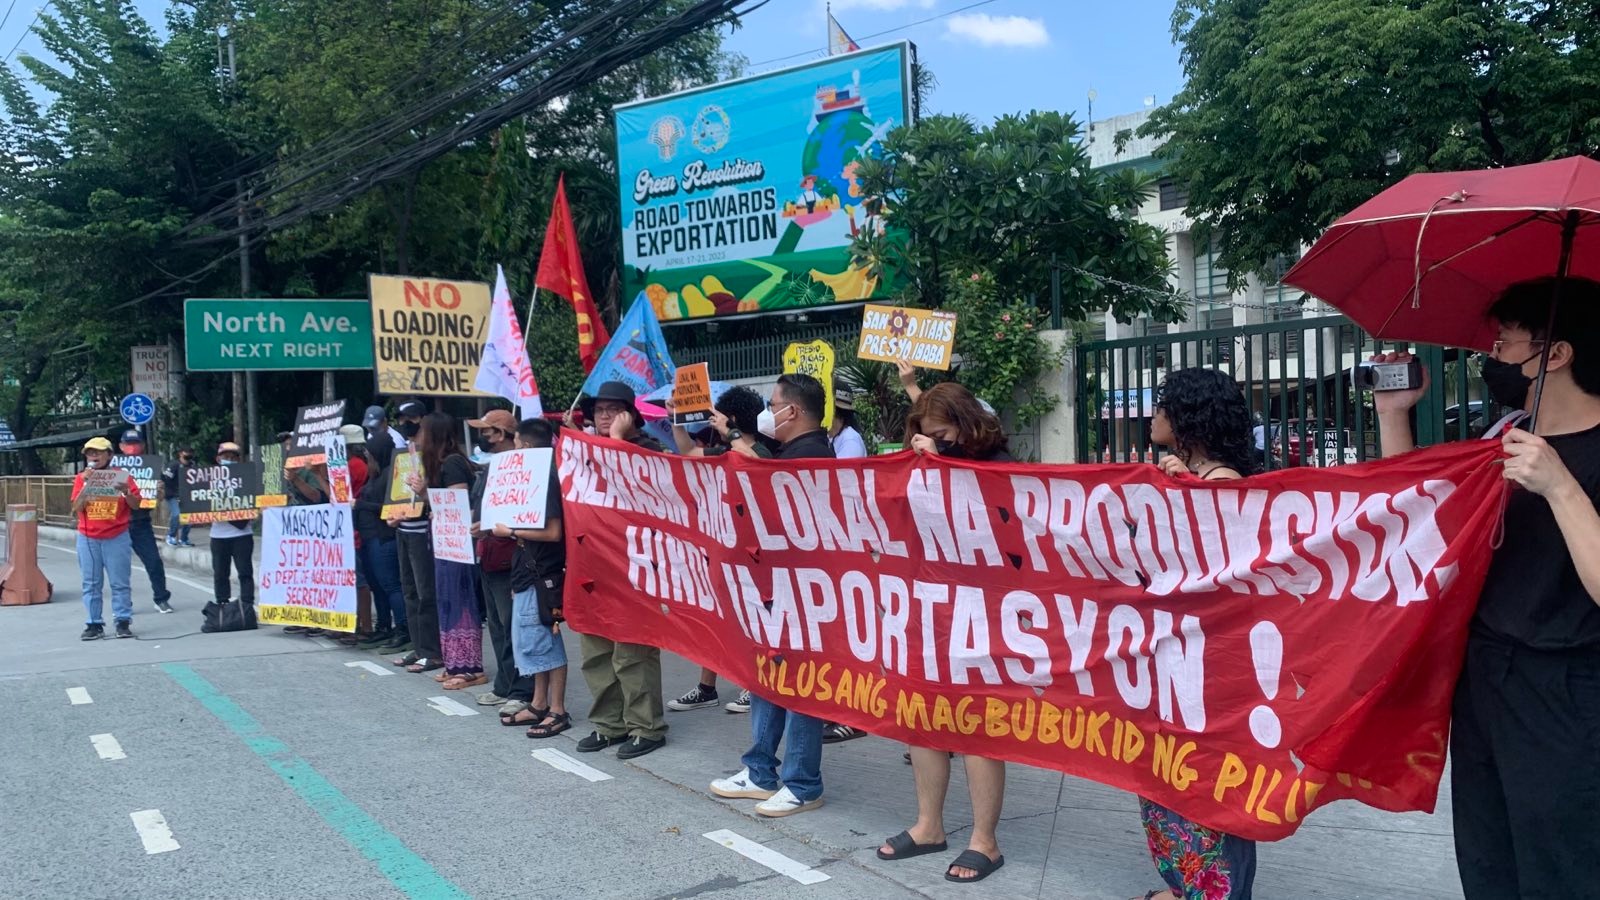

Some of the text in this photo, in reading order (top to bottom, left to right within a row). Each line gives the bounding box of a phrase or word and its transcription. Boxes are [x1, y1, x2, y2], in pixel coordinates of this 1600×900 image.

[633, 158, 764, 202] Green Revolution
[634, 187, 776, 230] ROAD TOWARDS
[636, 214, 778, 257] EXPORTATION
[665, 258, 685, 266] APRIL
[403, 280, 462, 310] NO
[203, 311, 358, 333] North Ave.
[220, 343, 343, 358] NEXT RIGHT
[145, 361, 166, 372] NO
[408, 366, 470, 393] ZONE
[109, 455, 143, 467] AHOD
[497, 452, 524, 470] LUPA
[186, 465, 230, 484] SAHOD
[209, 477, 243, 490] ITAAS!
[191, 487, 235, 501] PRESYO
[211, 494, 254, 511] IBABA!
[281, 508, 344, 540] MARCOS JR
[558, 436, 1459, 607] PALAKASIN ANG LOKAL NA PRODUKSYON
[278, 539, 344, 568] STEP DOWN
[261, 572, 271, 589] AS
[312, 568, 356, 587] AGRICULTURE
[626, 525, 724, 620] HINDI
[286, 586, 339, 609] SECRETARY!
[755, 653, 1327, 825] KILUSANG MAGBUBUKID NG PILI
